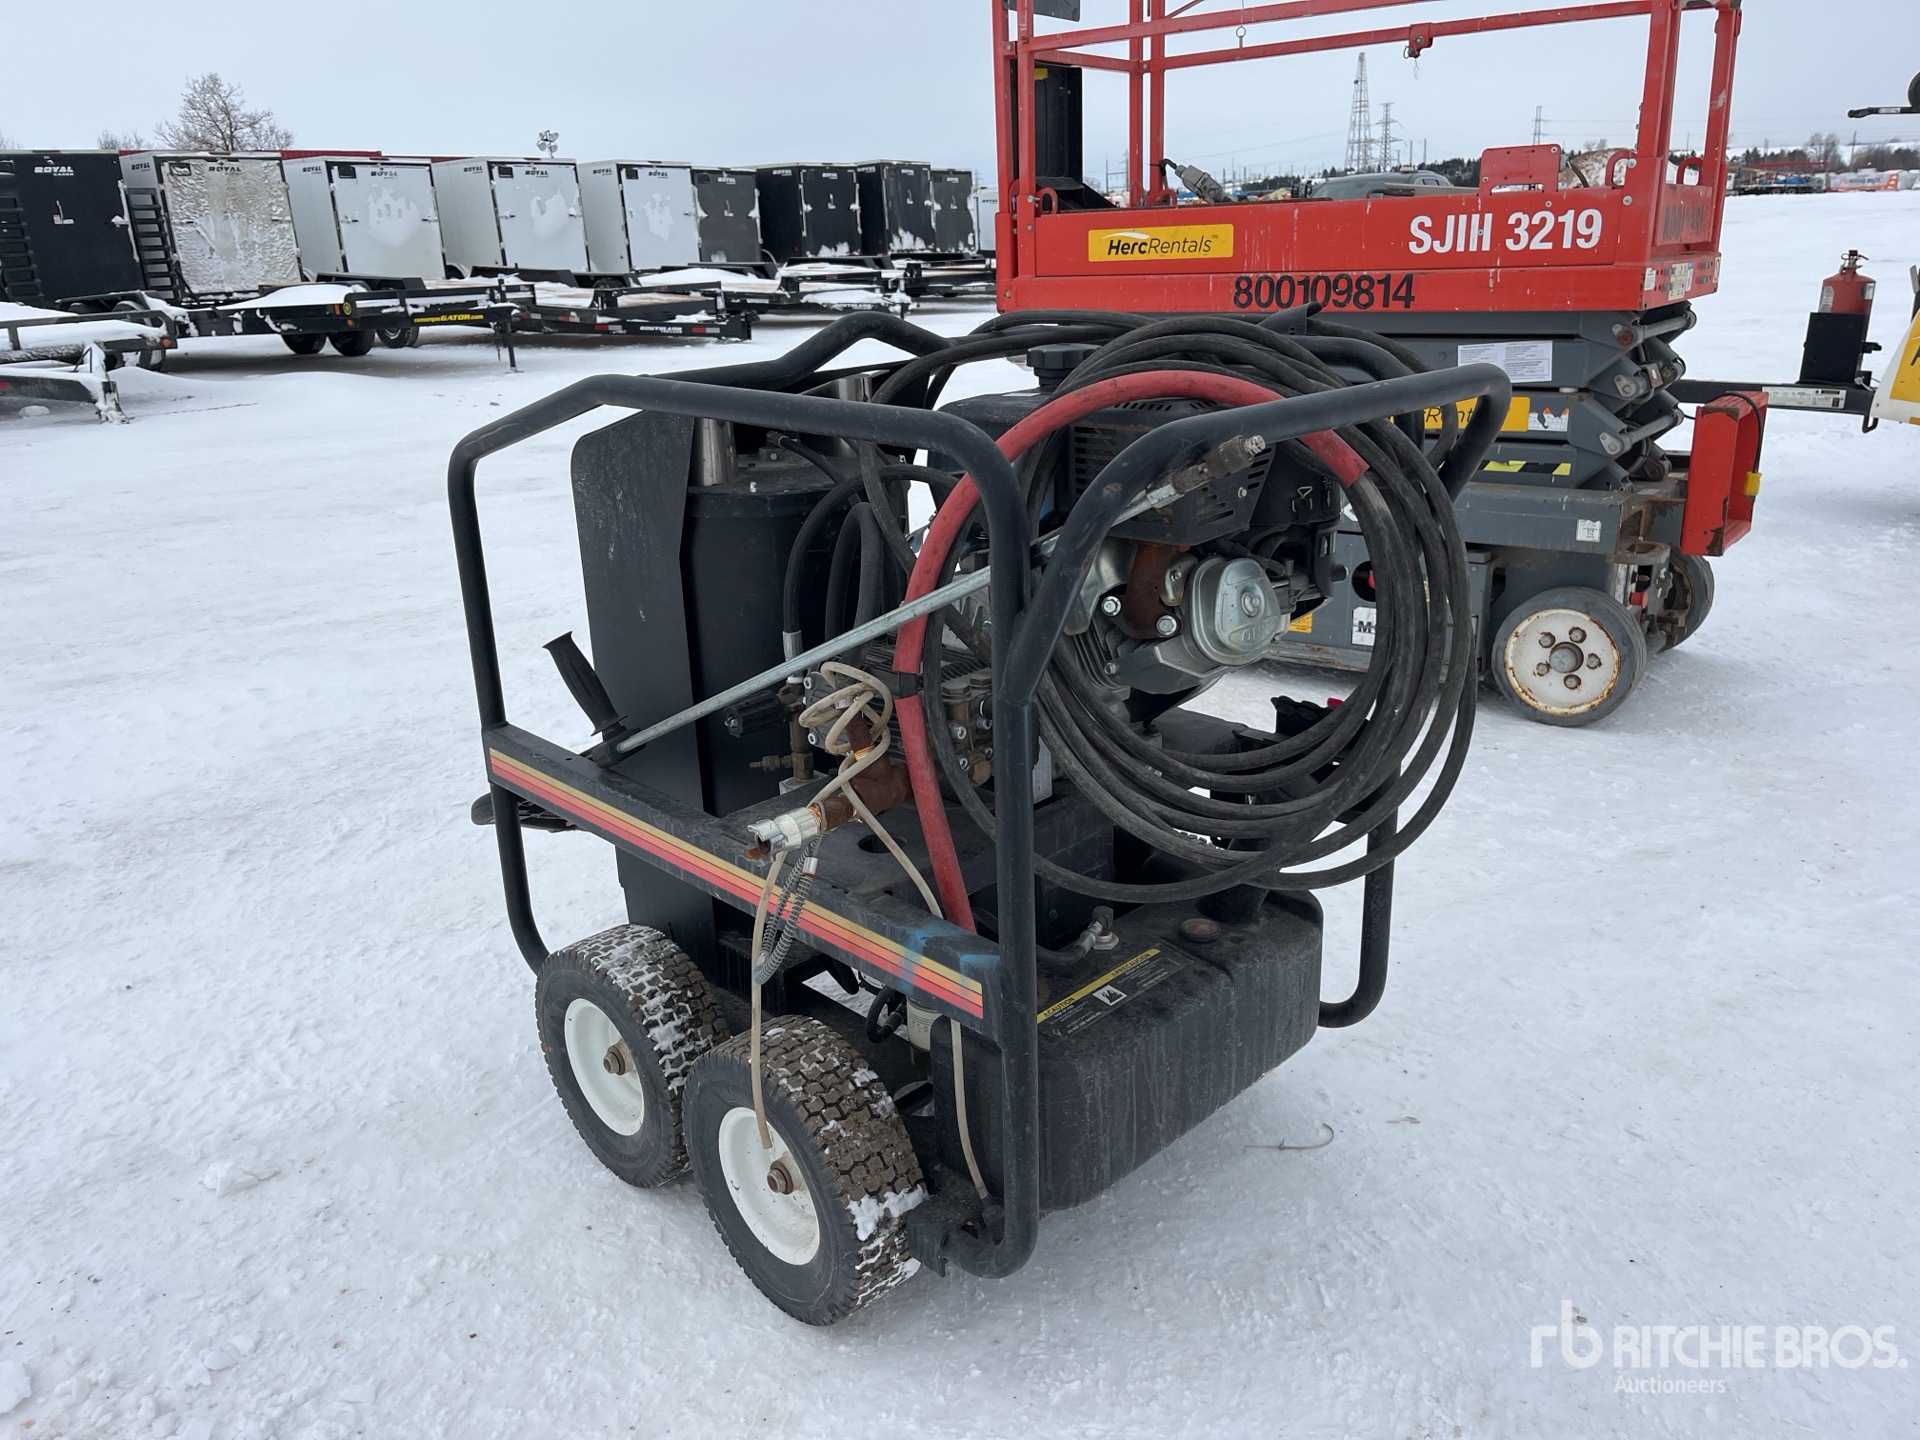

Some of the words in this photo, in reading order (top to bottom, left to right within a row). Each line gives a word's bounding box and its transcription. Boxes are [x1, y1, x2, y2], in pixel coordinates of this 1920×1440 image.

[131, 162, 150, 171] ROYAL
[1408, 212, 1493, 254] SJIH
[1505, 208, 1602, 251] 3219
[1233, 273, 1415, 309] 800109814
[1047, 997, 1075, 1015] CAUTION
